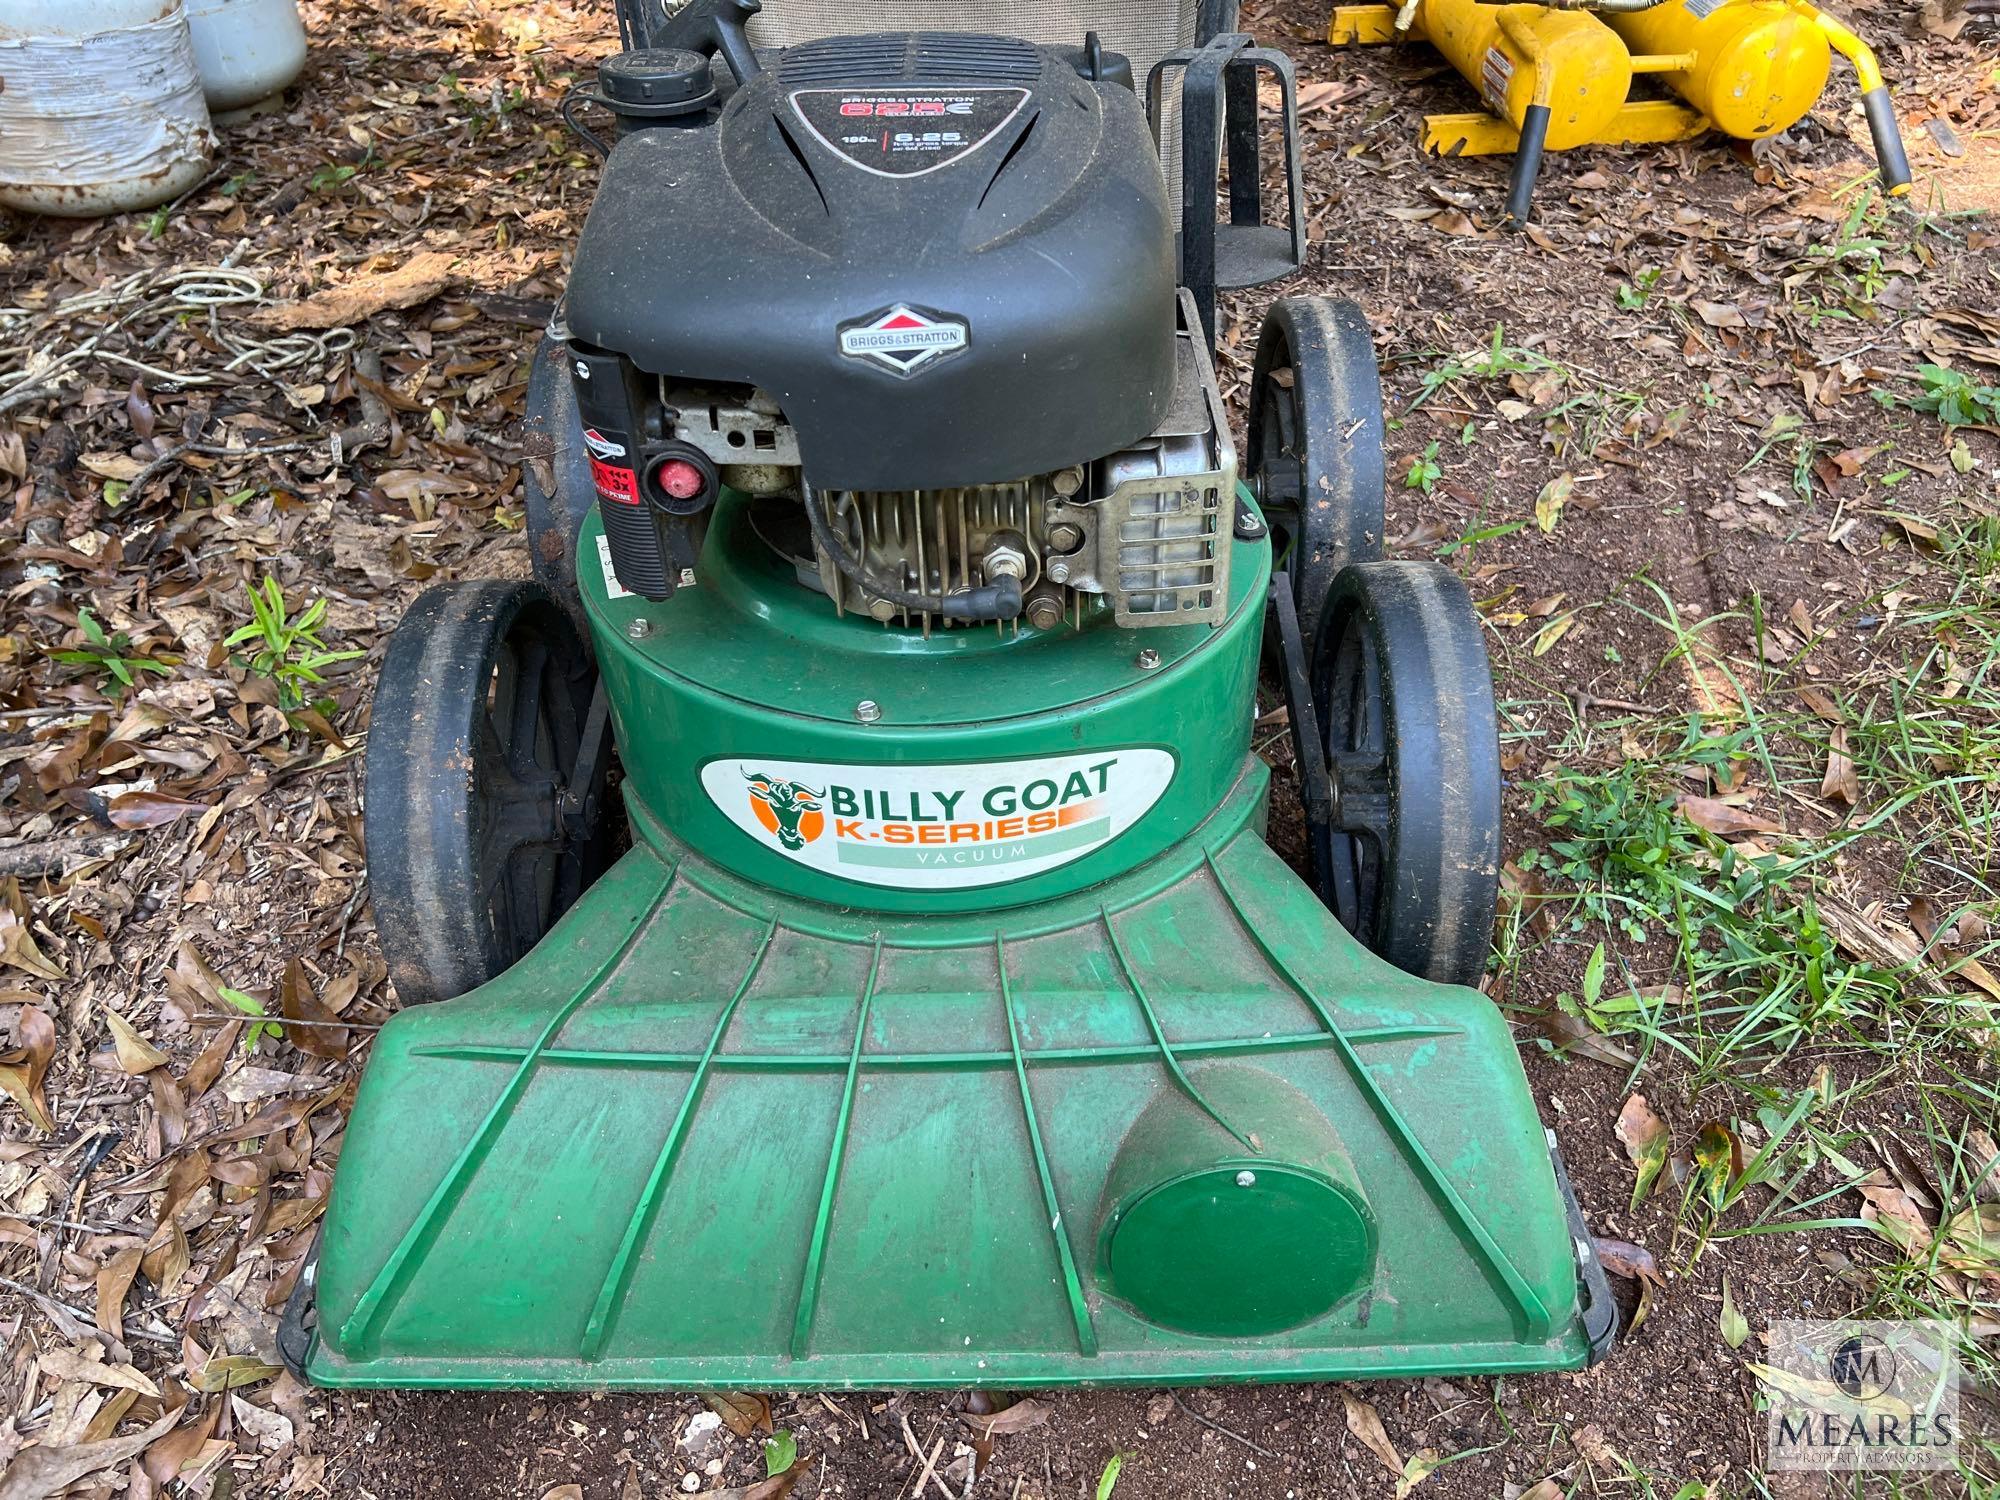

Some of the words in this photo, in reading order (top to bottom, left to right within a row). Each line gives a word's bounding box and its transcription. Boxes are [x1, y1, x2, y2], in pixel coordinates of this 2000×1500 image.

[894, 132, 961, 142] 6.25
[609, 490, 633, 502] PRIME
[829, 784, 966, 821] BILLY
[981, 757, 1119, 817] GOAT
[835, 810, 1058, 844] K-SERIES
[916, 844, 1027, 865] VACUUM
